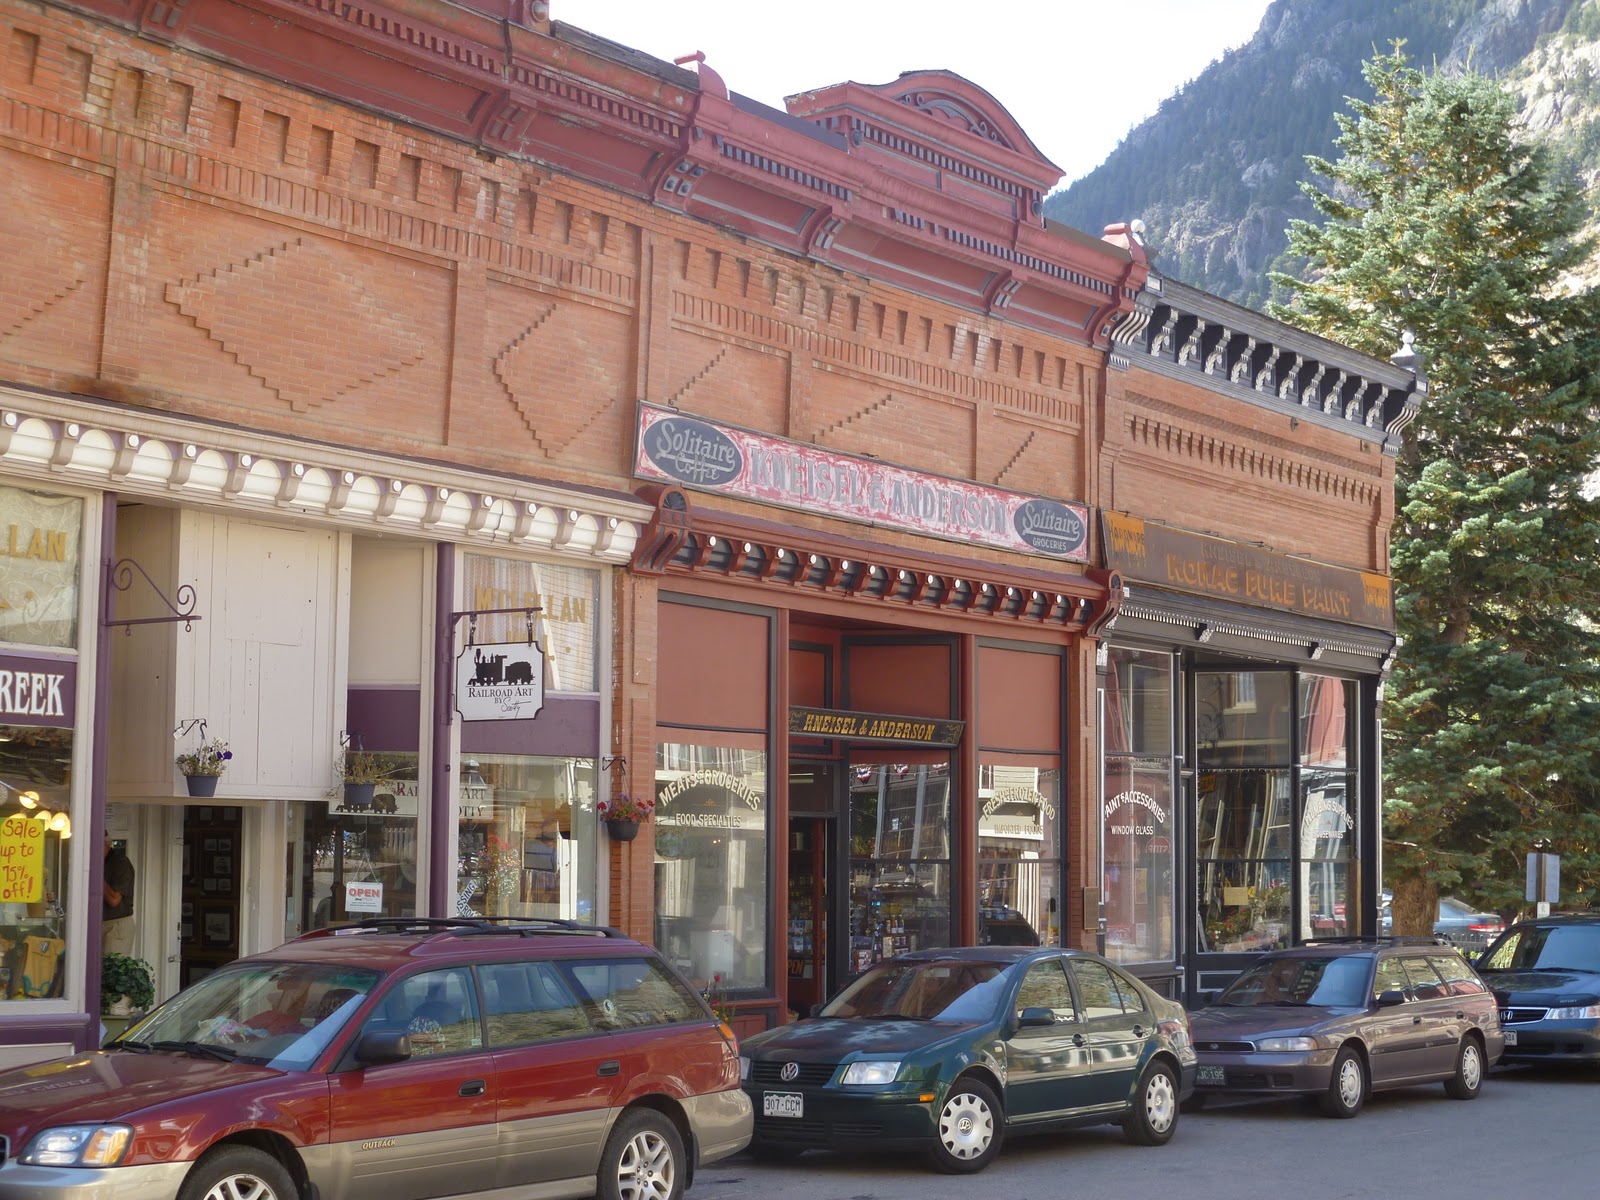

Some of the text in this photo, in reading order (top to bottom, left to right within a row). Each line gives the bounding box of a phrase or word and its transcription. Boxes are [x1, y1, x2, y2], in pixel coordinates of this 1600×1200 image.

[656, 420, 736, 466] Solitaire
[675, 451, 720, 482] Coffee
[750, 446, 864, 505] KNEISEL
[891, 479, 1008, 535] ANDERSON
[1021, 504, 1081, 541] Solitaire
[0, 523, 67, 562] LAN
[1032, 536, 1067, 551] GROCERIES
[468, 686, 533, 698] RAILROAD ART
[803, 714, 936, 741] KNEISEL & ANDERSON
[461, 787, 486, 800] ART
[659, 772, 697, 807] MEATS
[704, 769, 760, 811] GROCERIES
[982, 789, 1005, 821] FRESH
[1009, 787, 1039, 805] FROZEN
[1038, 795, 1055, 820] FOOD
[1104, 795, 1121, 821] AINT
[1124, 790, 1165, 823] ACCESSORIES
[1332, 800, 1354, 830] SUPPLIES
[3, 819, 41, 838] Sale
[676, 813, 742, 828] FOOD SPECIALTIES
[1111, 825, 1154, 835] WINDOW GLASS
[0, 842, 34, 863] up to
[348, 887, 380, 898] OPEN
[362, 1138, 396, 1150] OUTBACK
